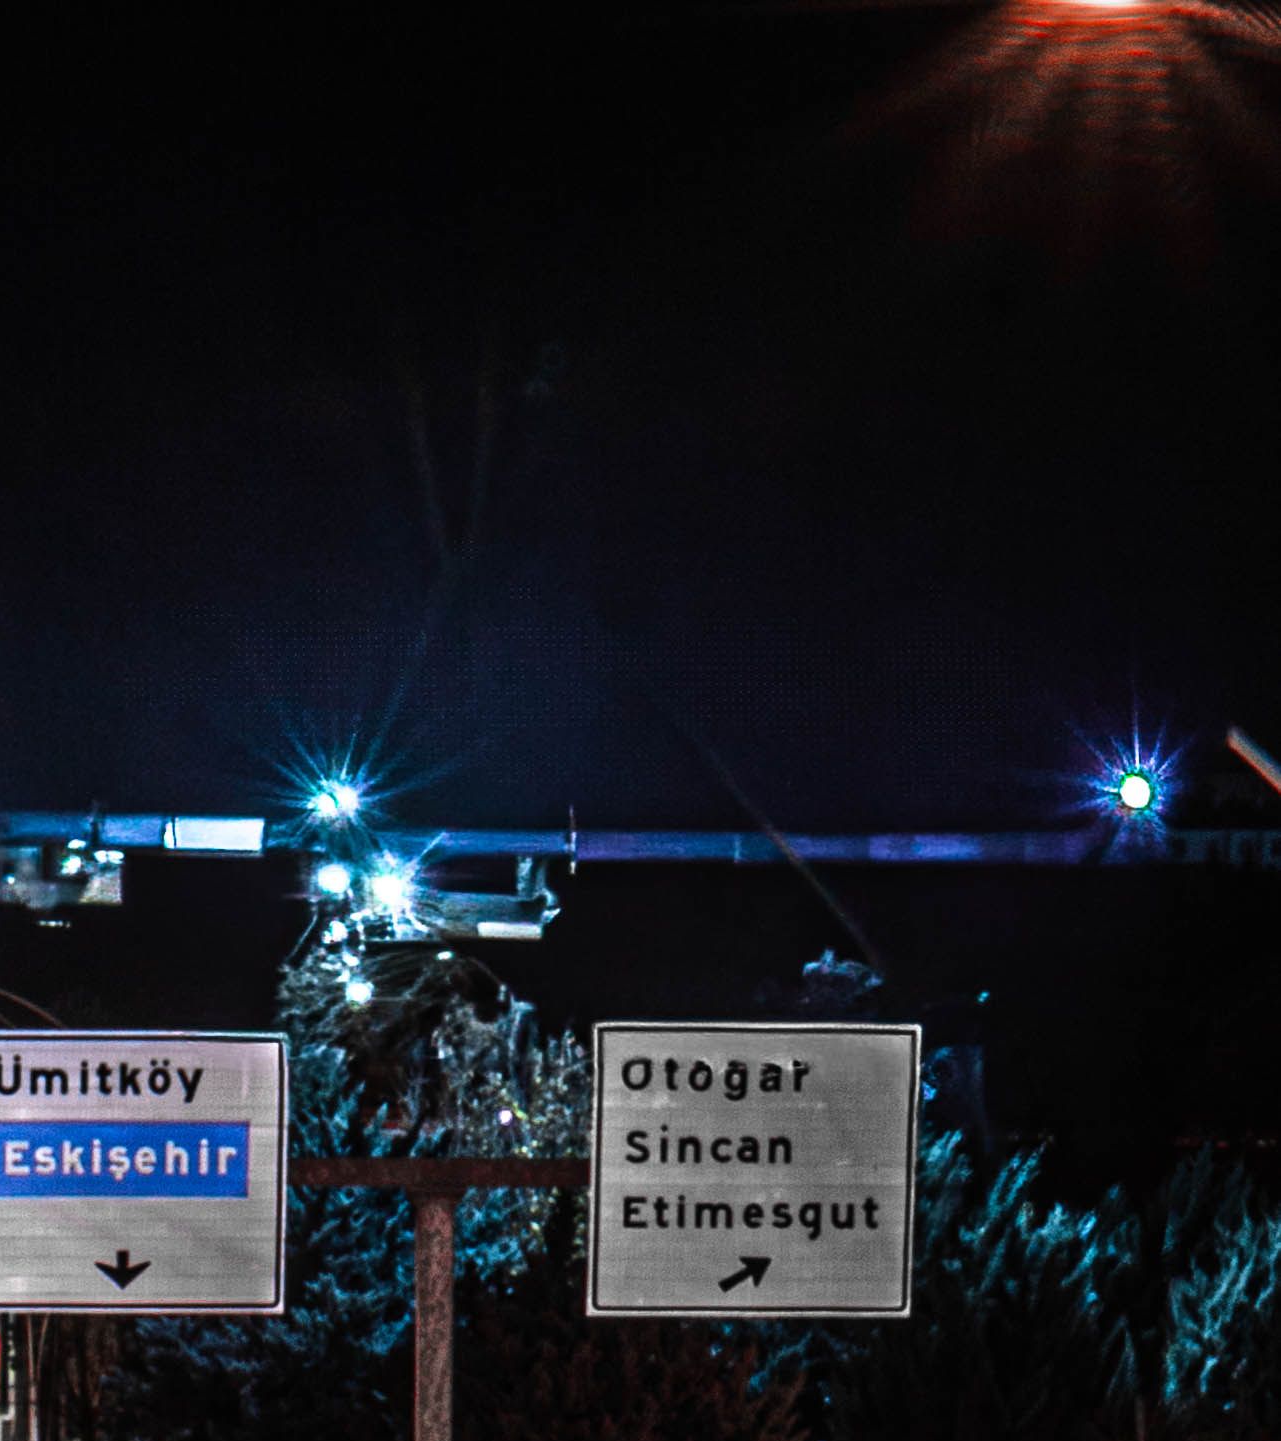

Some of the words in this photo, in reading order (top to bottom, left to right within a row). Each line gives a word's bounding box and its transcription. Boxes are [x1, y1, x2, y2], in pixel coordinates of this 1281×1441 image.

[621, 1057, 811, 1102] Otogar
[3, 1138, 238, 1181] Eskişehir
[625, 1124, 793, 1165] Sincan
[622, 1194, 880, 1241] Etimesgut
